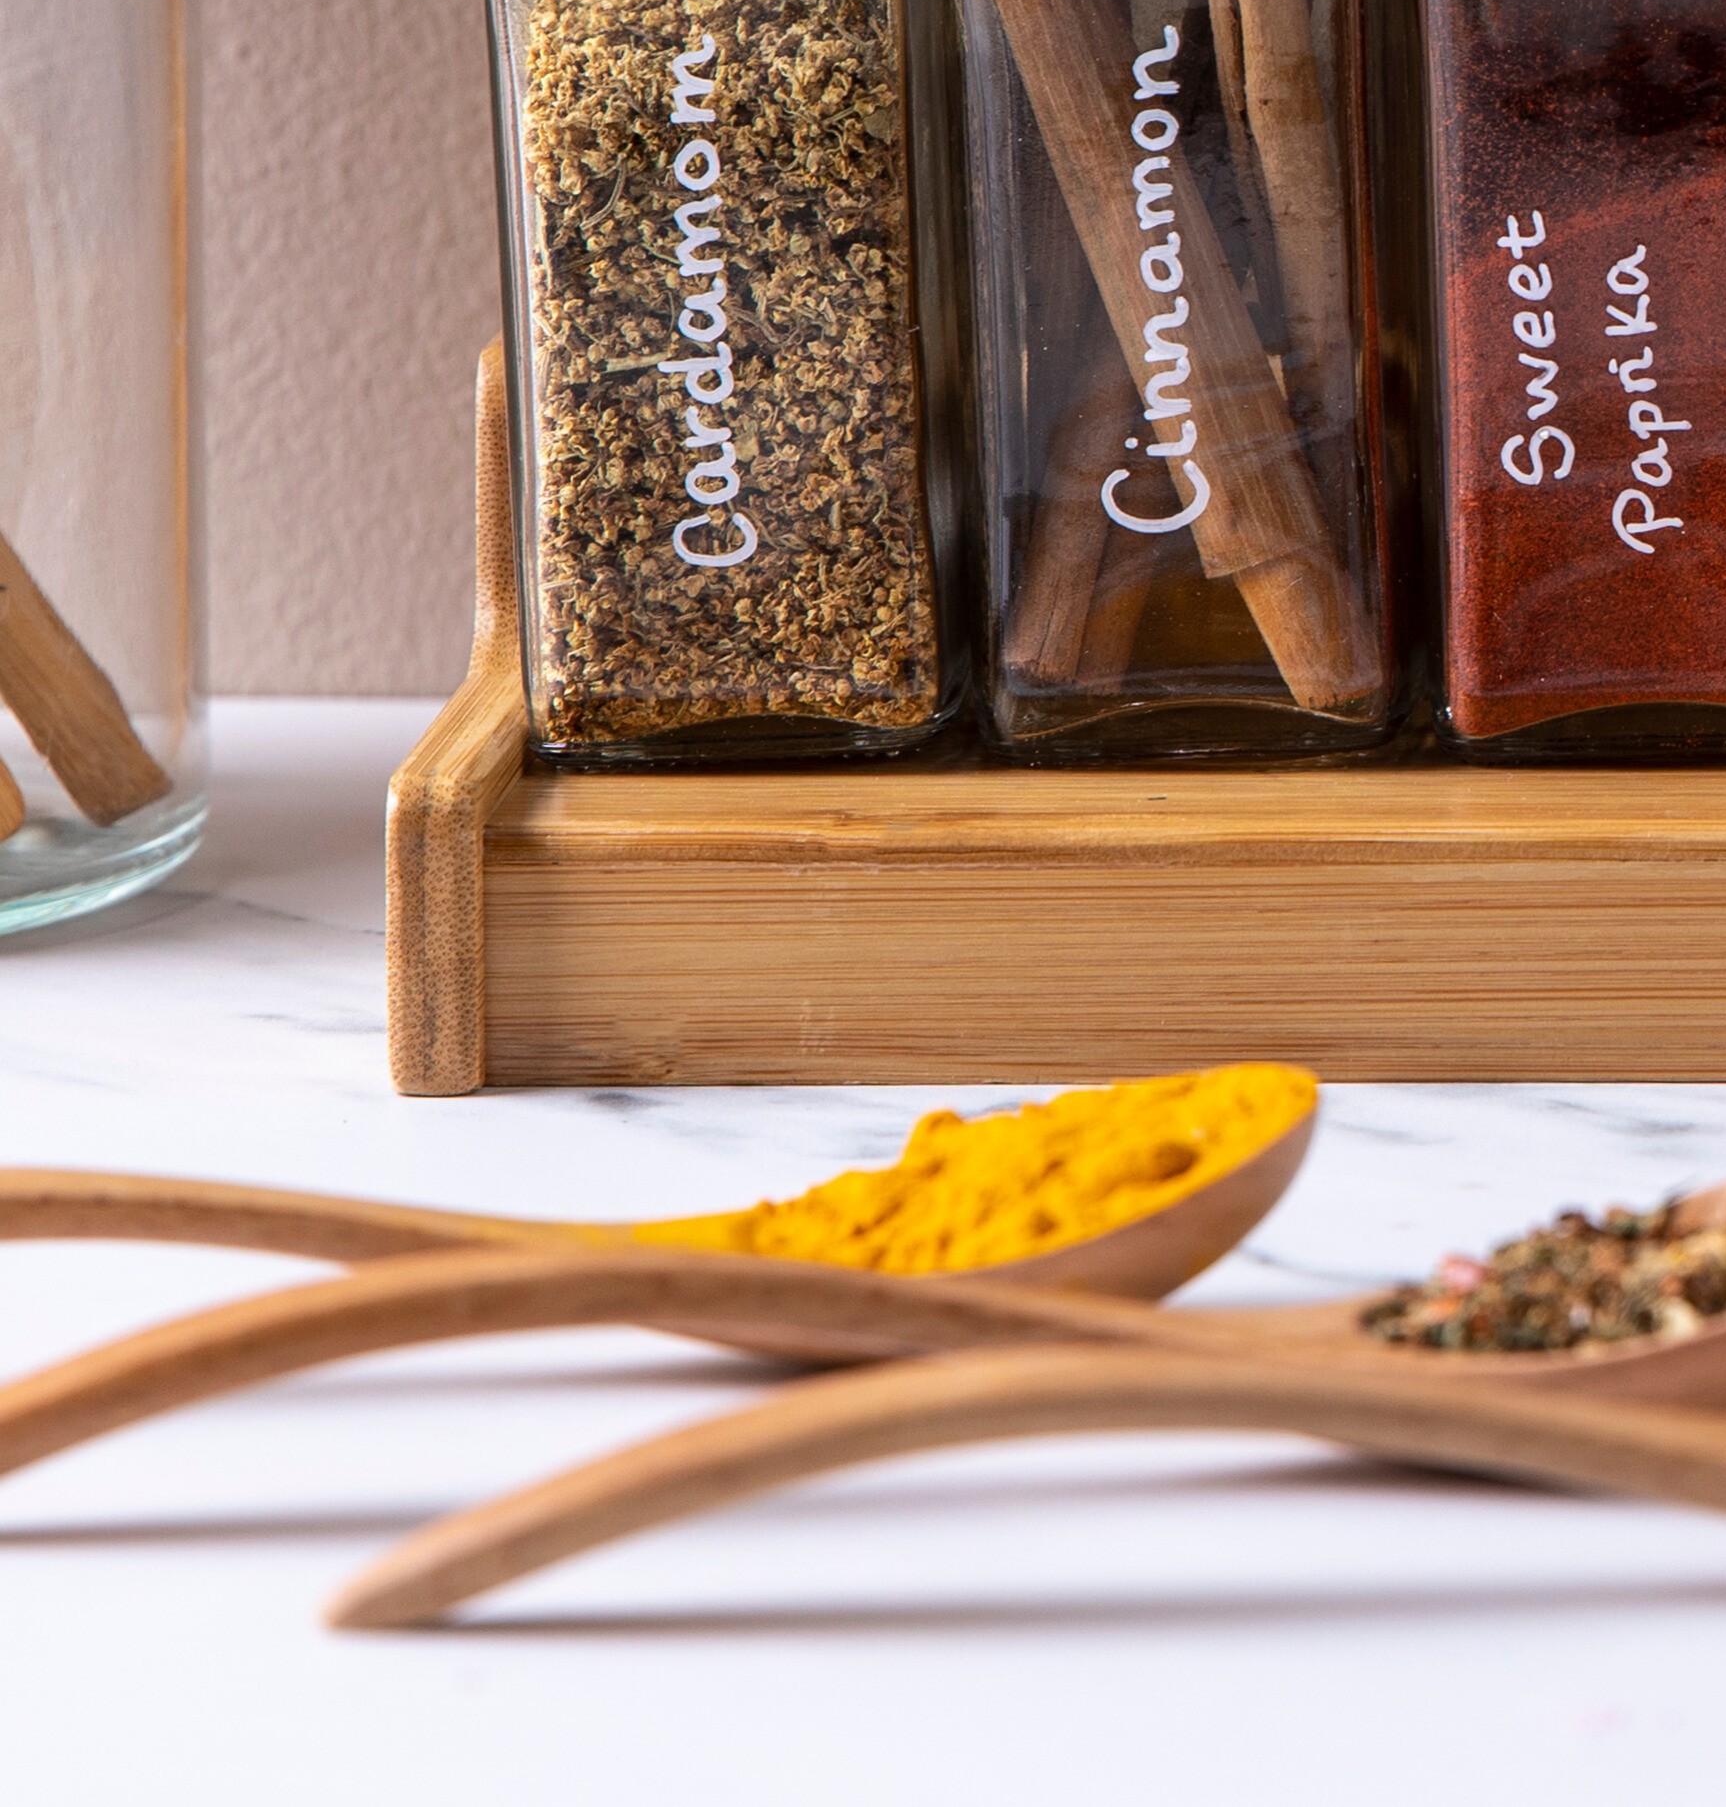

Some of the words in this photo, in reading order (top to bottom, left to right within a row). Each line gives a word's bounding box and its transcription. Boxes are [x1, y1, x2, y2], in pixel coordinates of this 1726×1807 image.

[657, 33, 758, 568] Cardamom
[1101, 24, 1211, 533] Cinnamon
[1496, 208, 1575, 486] Sweet
